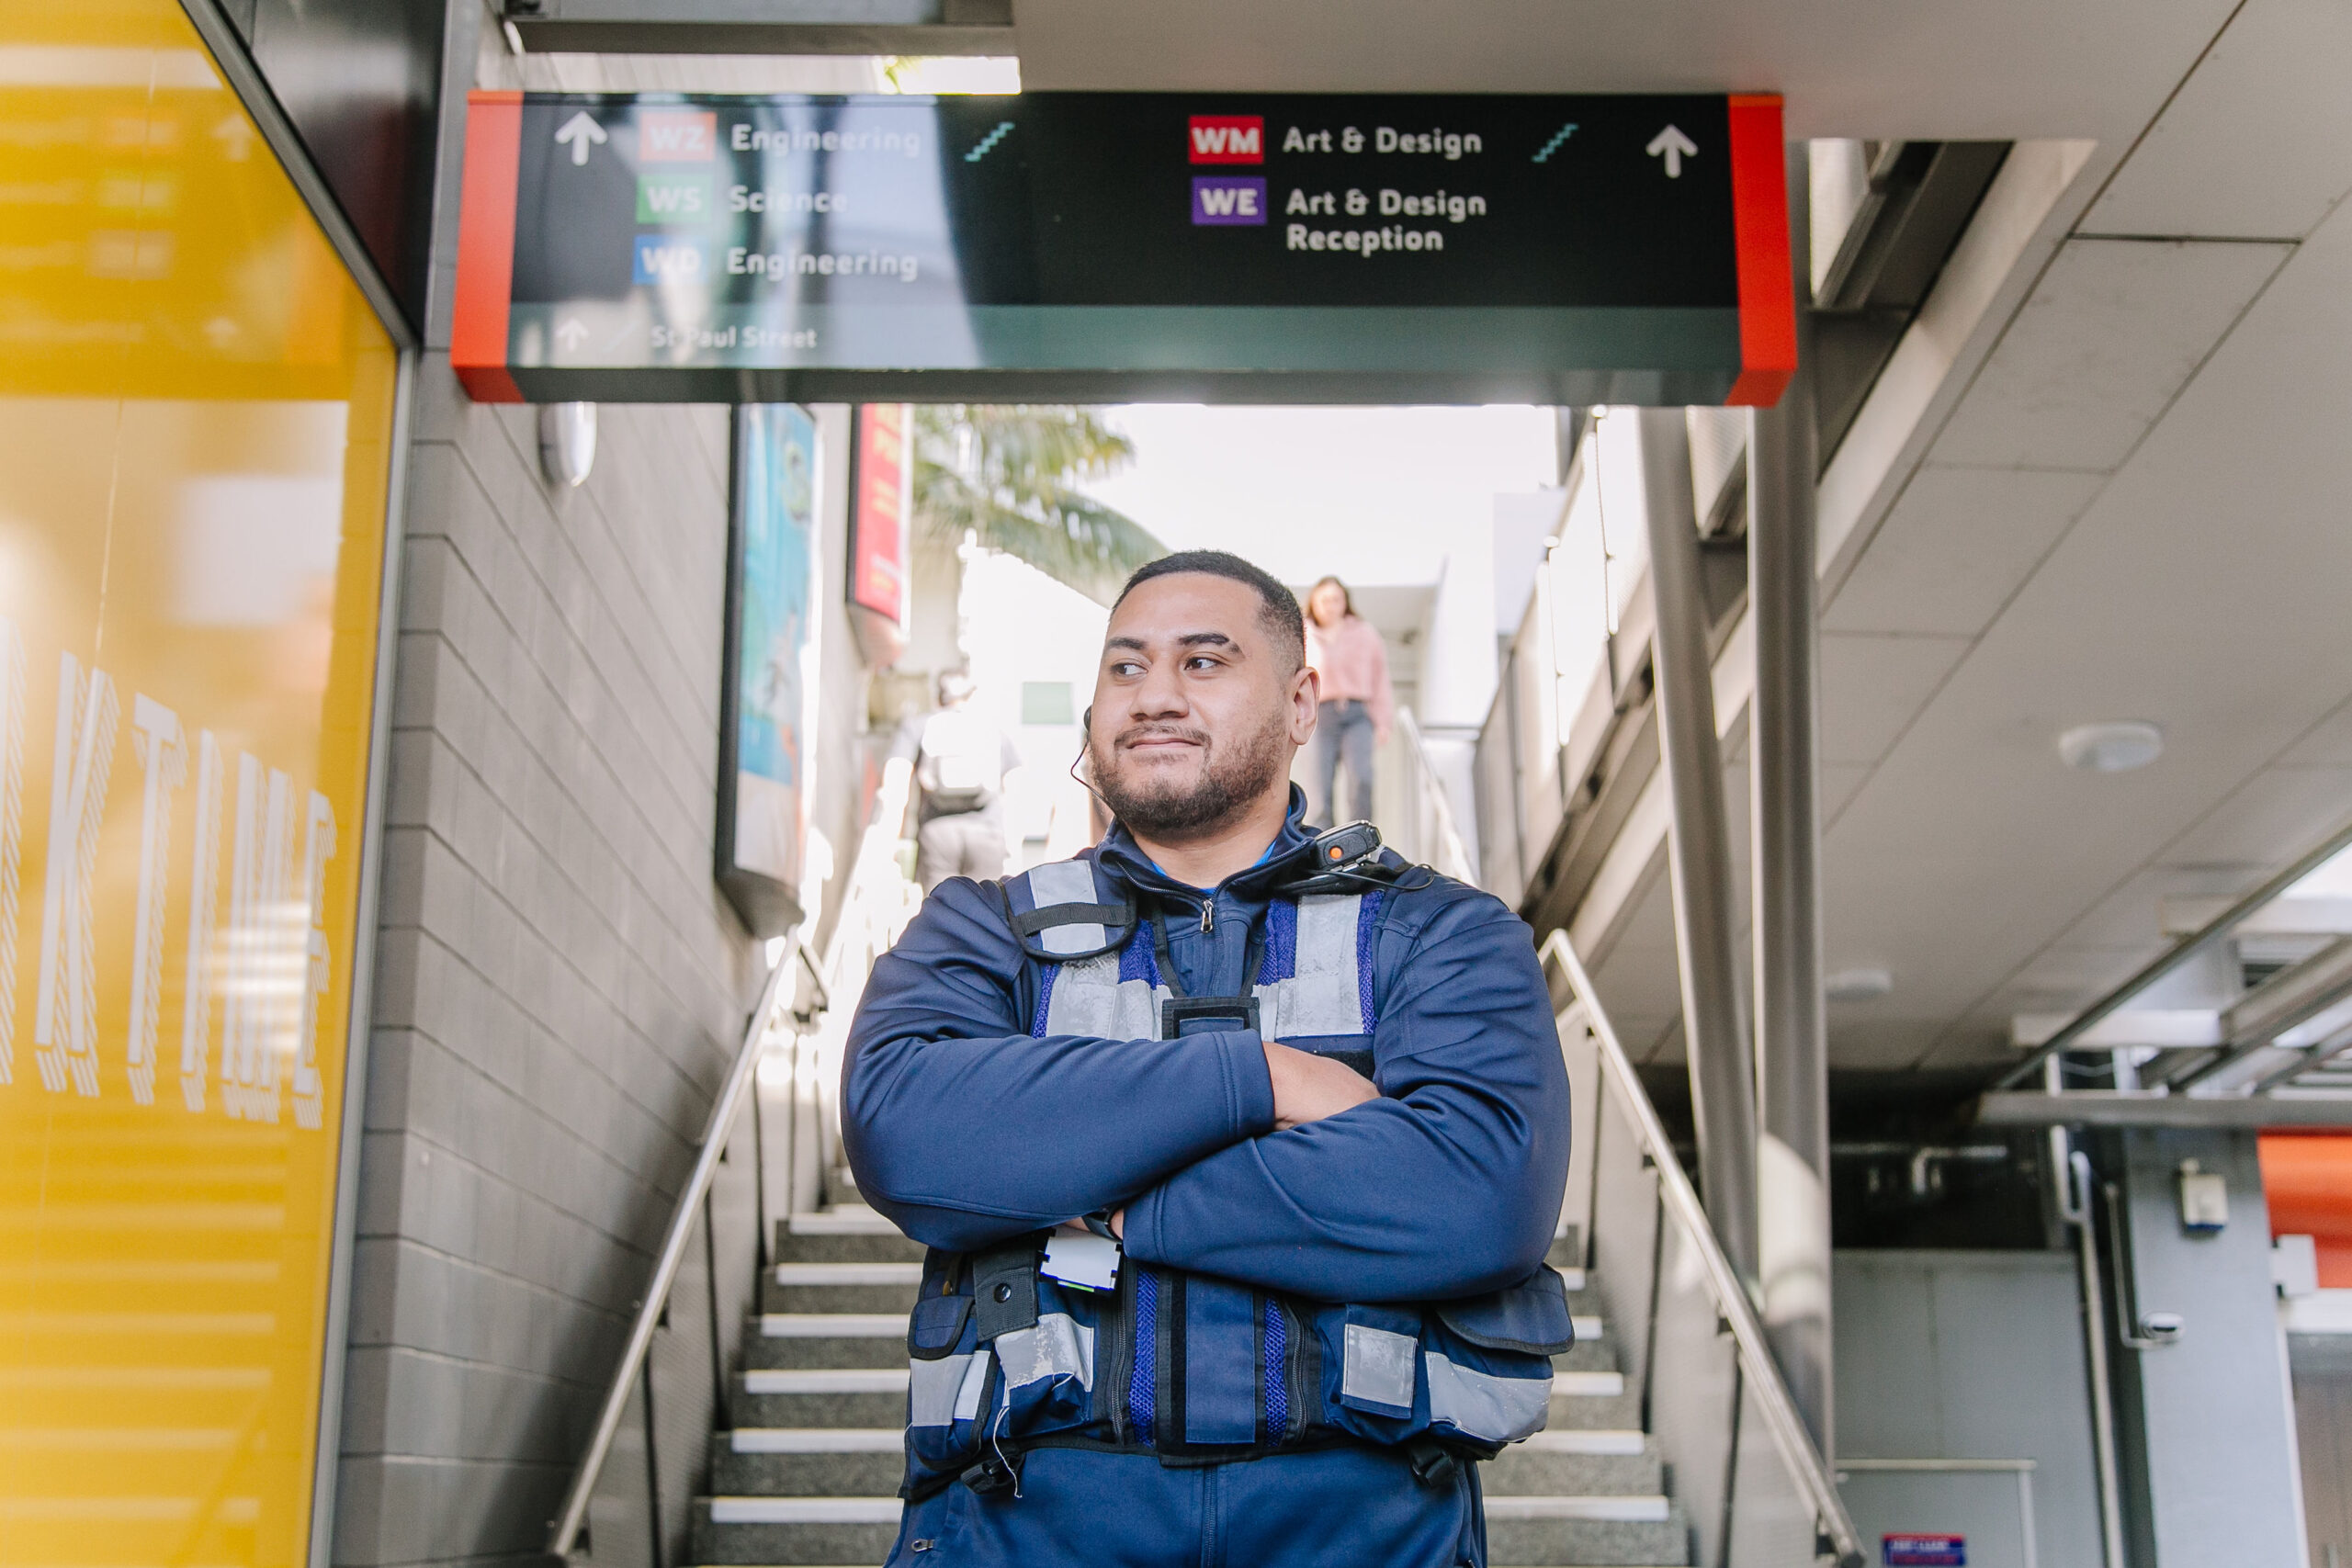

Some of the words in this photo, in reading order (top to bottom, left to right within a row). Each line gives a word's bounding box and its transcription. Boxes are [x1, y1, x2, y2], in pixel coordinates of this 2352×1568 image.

[650, 125, 707, 152] WZ
[731, 123, 921, 157] Engineering
[1191, 127, 1261, 154] WM
[1283, 126, 1333, 153] Art
[1340, 126, 1366, 153] &
[1375, 126, 1483, 160] Design
[647, 186, 703, 213] WS
[729, 184, 849, 213] Science
[1199, 187, 1259, 215] WE
[1285, 187, 1337, 215] Art
[1345, 187, 1370, 215] &
[1379, 187, 1487, 222] Design
[1286, 223, 1444, 257] Reception
[641, 246, 702, 274] WD
[727, 246, 919, 283] Engineering
[650, 325, 676, 348] St
[687, 325, 737, 348] Paul
[741, 325, 817, 348] Street
